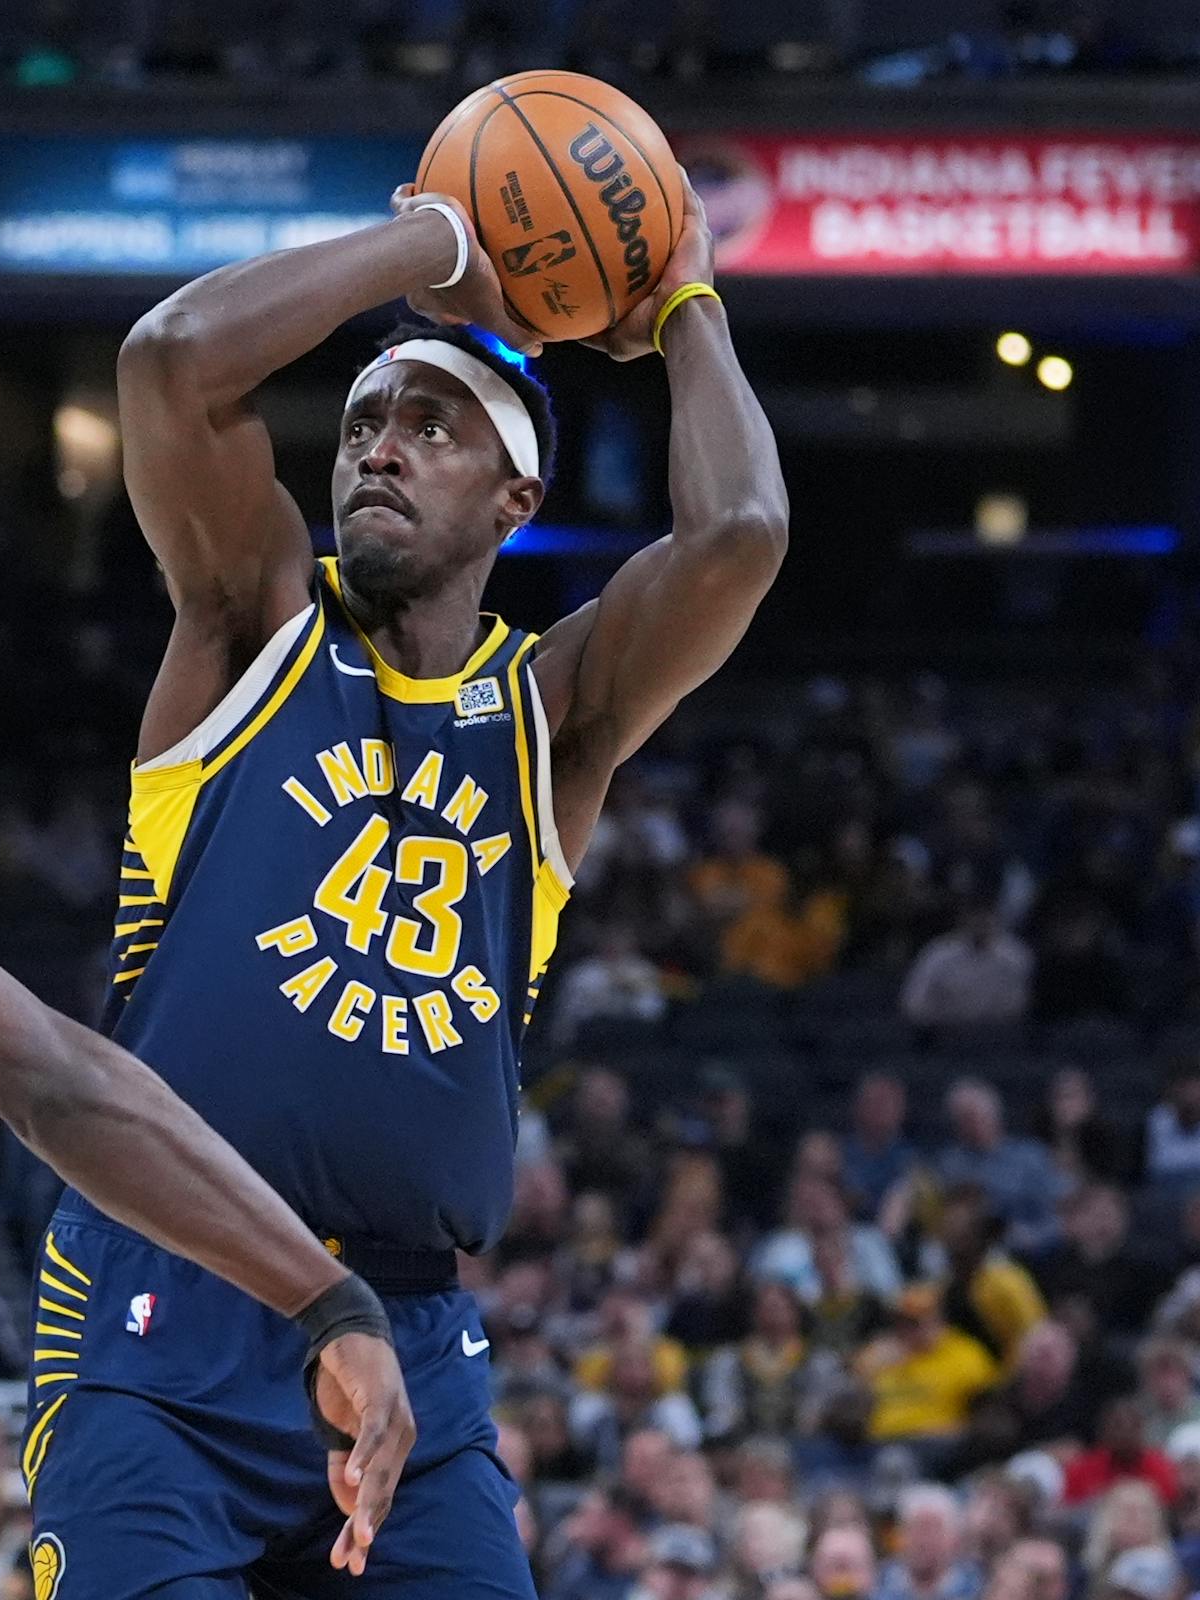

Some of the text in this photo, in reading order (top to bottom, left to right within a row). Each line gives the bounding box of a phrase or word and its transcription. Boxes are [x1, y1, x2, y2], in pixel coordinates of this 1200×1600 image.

[569, 121, 650, 296] Wilson
[453, 712, 512, 729] spokenote
[281, 738, 512, 876] INDANA
[313, 813, 469, 978] 43
[255, 914, 502, 1055] PACERS
